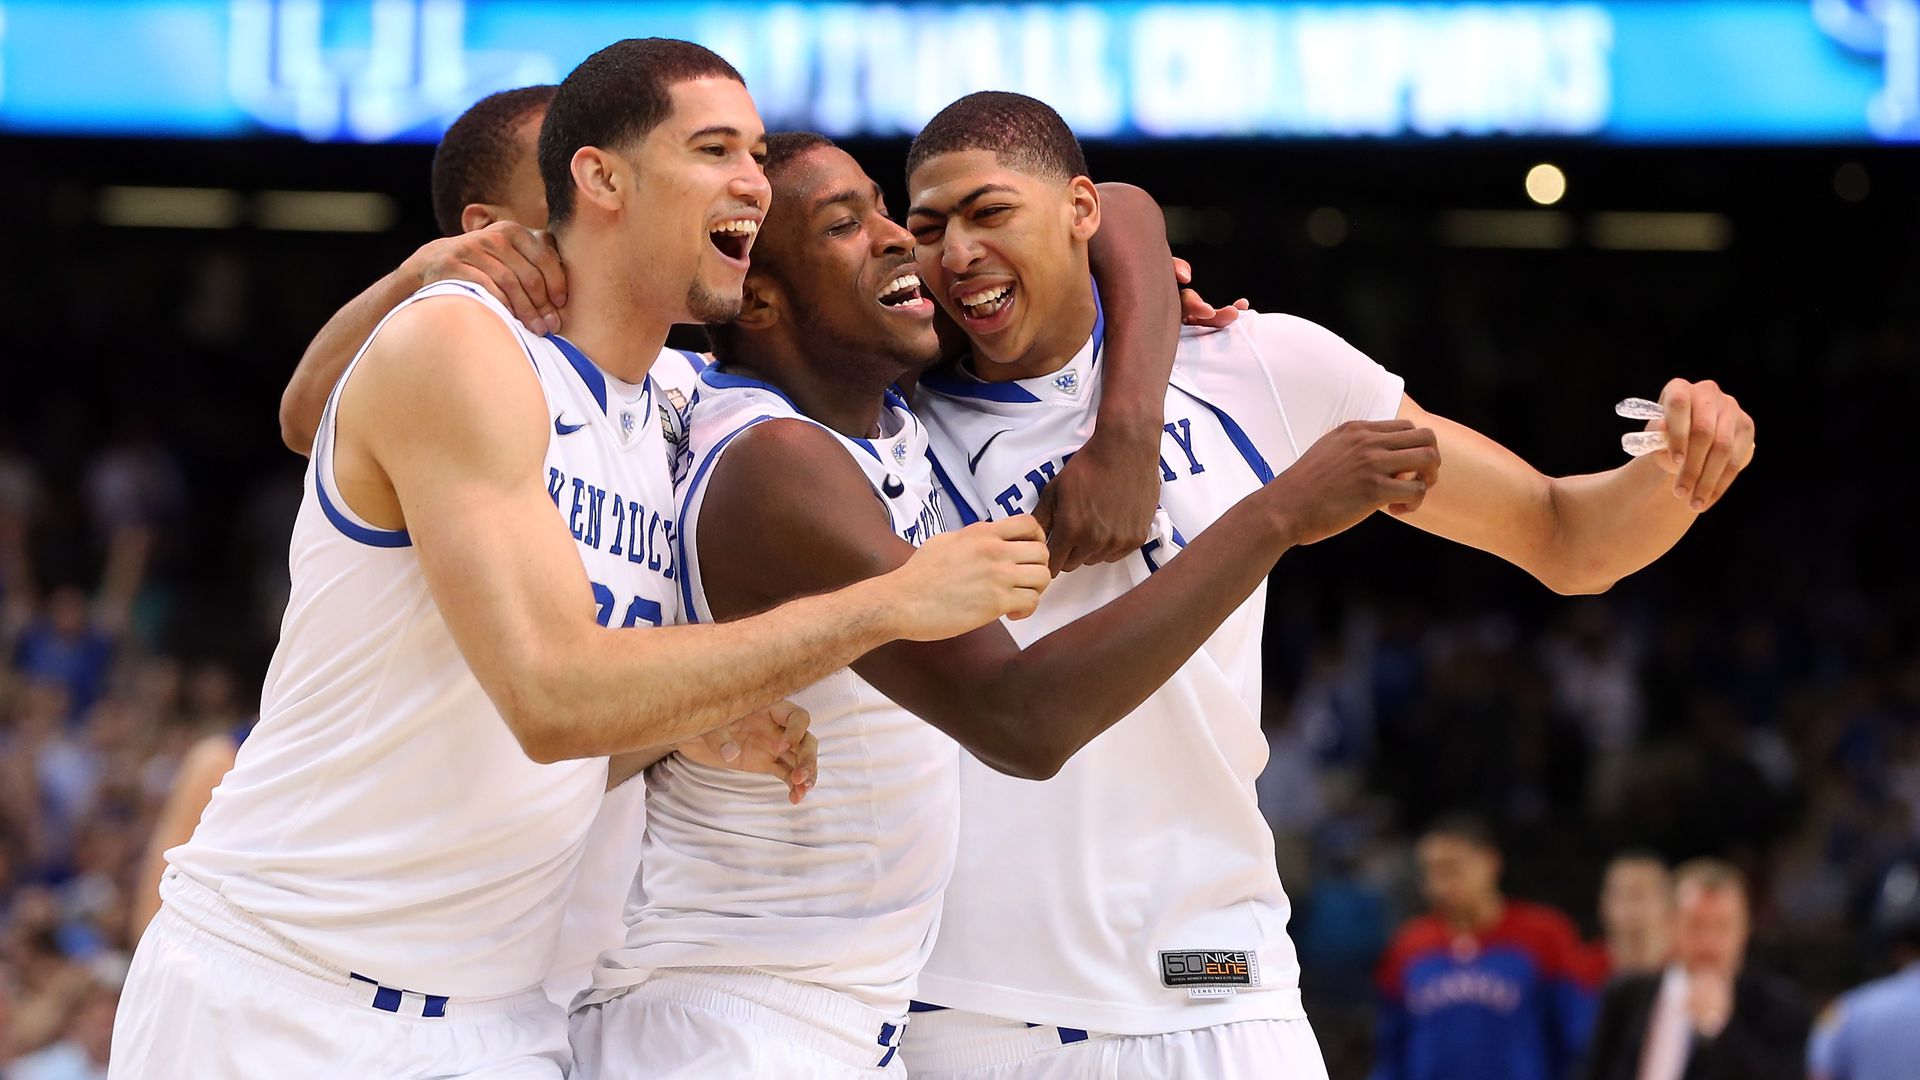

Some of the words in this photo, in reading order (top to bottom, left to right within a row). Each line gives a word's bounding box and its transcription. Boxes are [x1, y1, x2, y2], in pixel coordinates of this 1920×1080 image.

[548, 466, 678, 582] KENTUCK
[1167, 954, 1204, 974] 50
[1204, 952, 1246, 963] NIKE
[1206, 963, 1248, 975] ELITE
